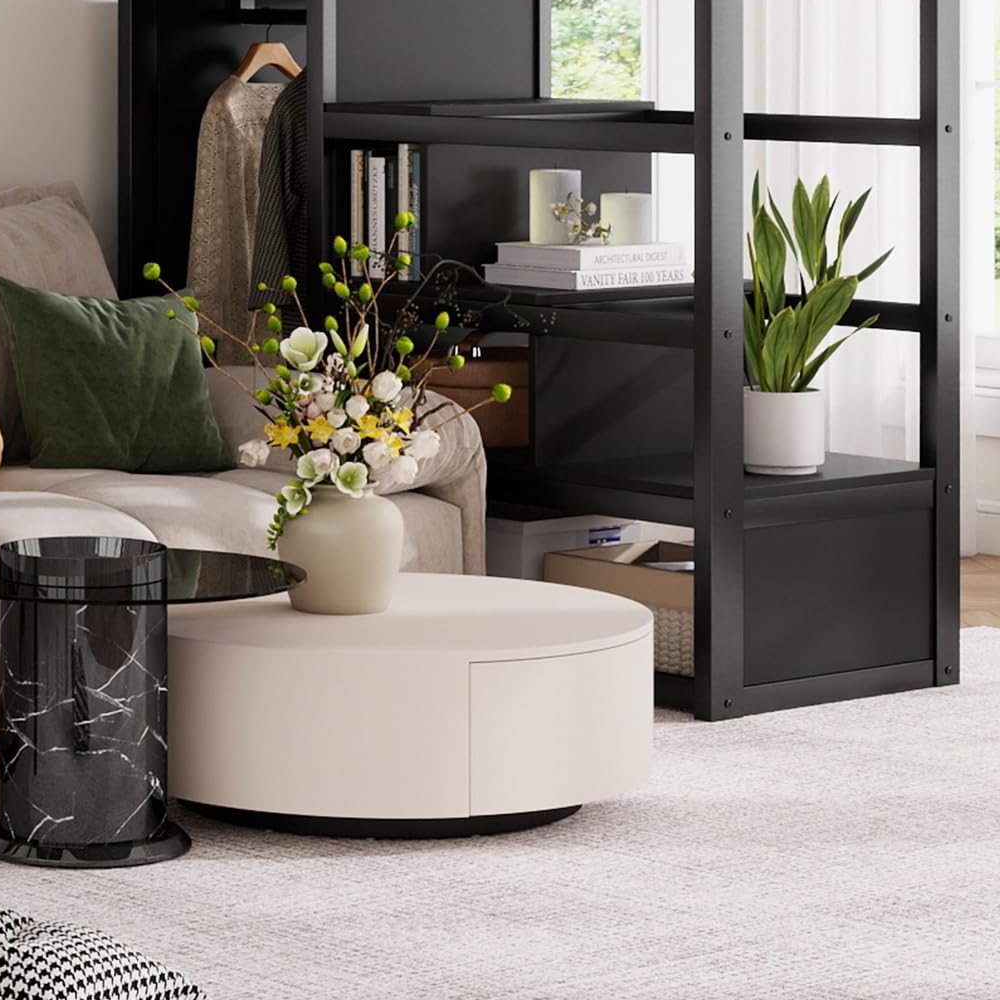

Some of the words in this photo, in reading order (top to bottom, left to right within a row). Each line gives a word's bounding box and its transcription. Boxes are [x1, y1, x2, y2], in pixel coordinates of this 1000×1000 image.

[594, 253, 643, 265] ARCHITECTURAL
[644, 251, 668, 261] DIGEST
[580, 273, 616, 287] VANITY
[618, 271, 640, 285] FAIR
[641, 271, 654, 284] 100
[656, 269, 685, 283] YEARS
